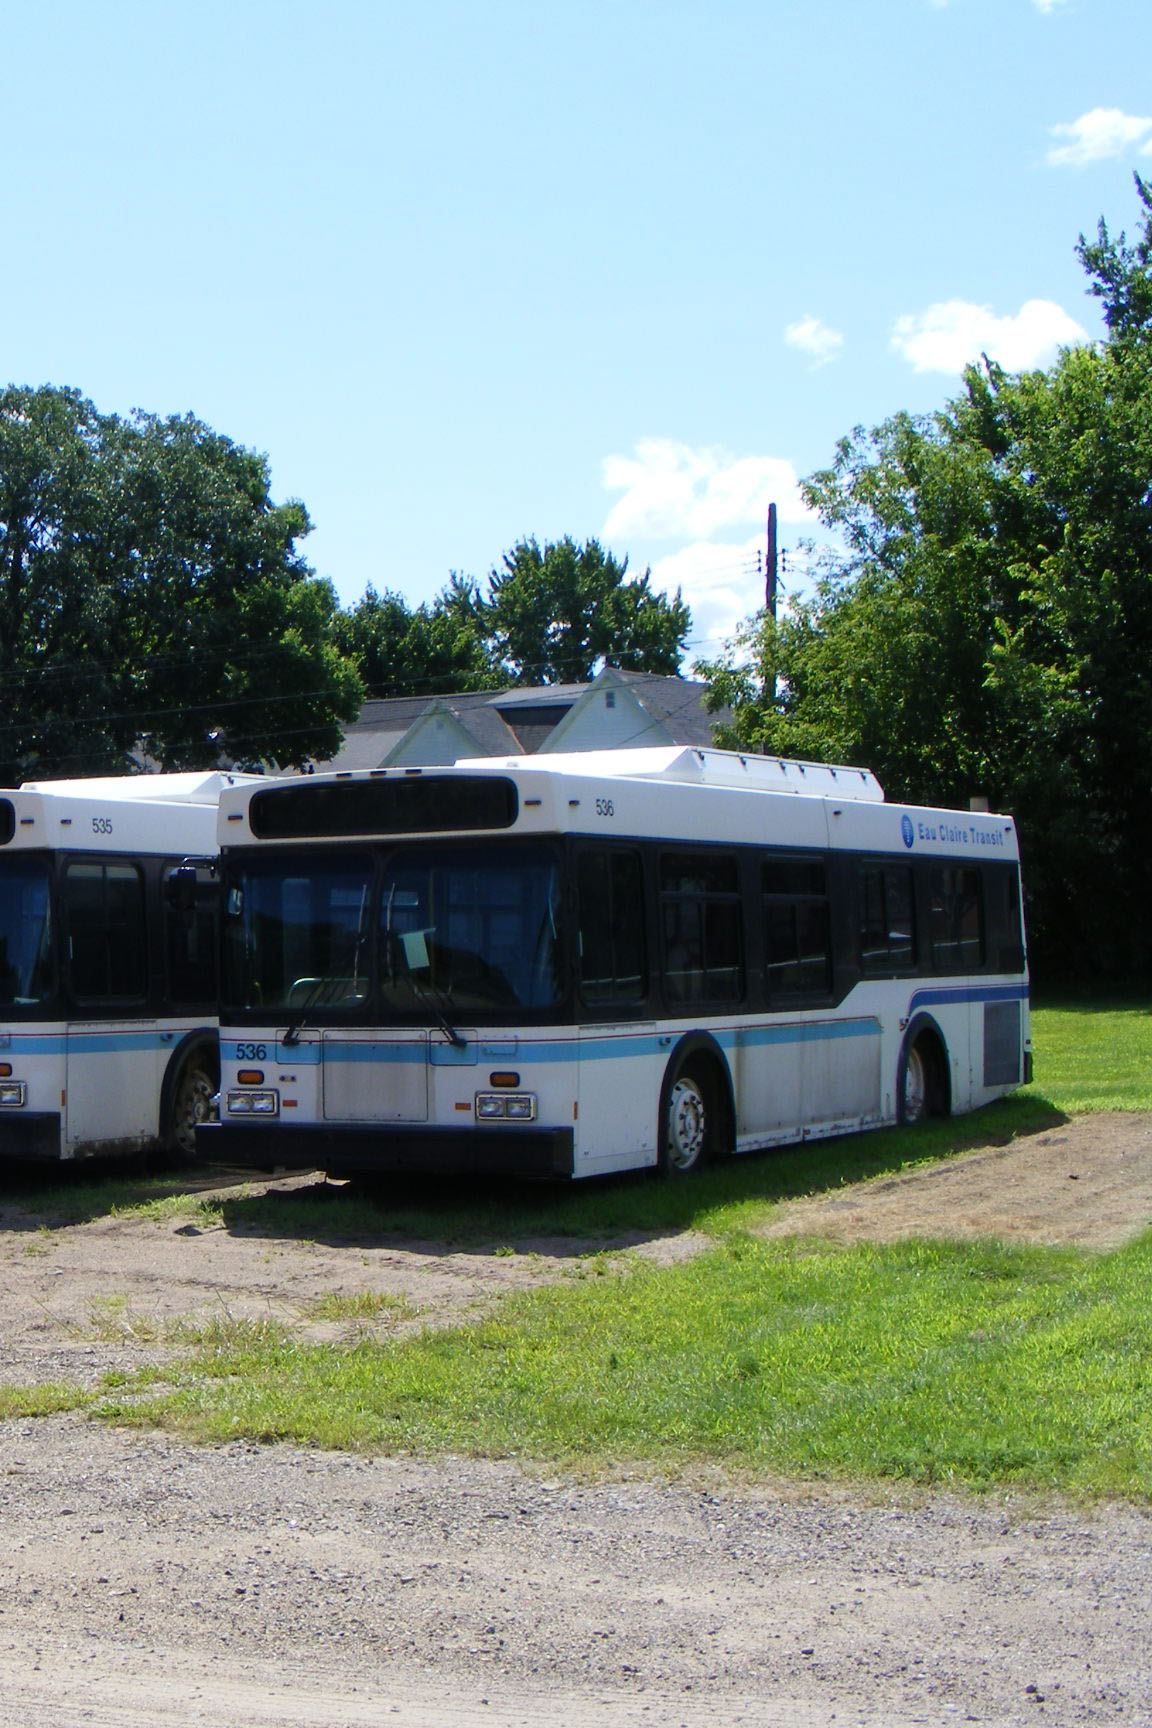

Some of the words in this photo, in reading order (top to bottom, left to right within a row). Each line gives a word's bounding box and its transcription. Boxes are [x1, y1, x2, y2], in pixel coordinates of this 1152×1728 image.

[596, 799, 614, 816] 536
[92, 817, 113, 834] 535
[918, 823, 937, 840] Eau
[939, 825, 968, 843] Claire
[970, 827, 1003, 846] Transit
[236, 1043, 267, 1061] 536
